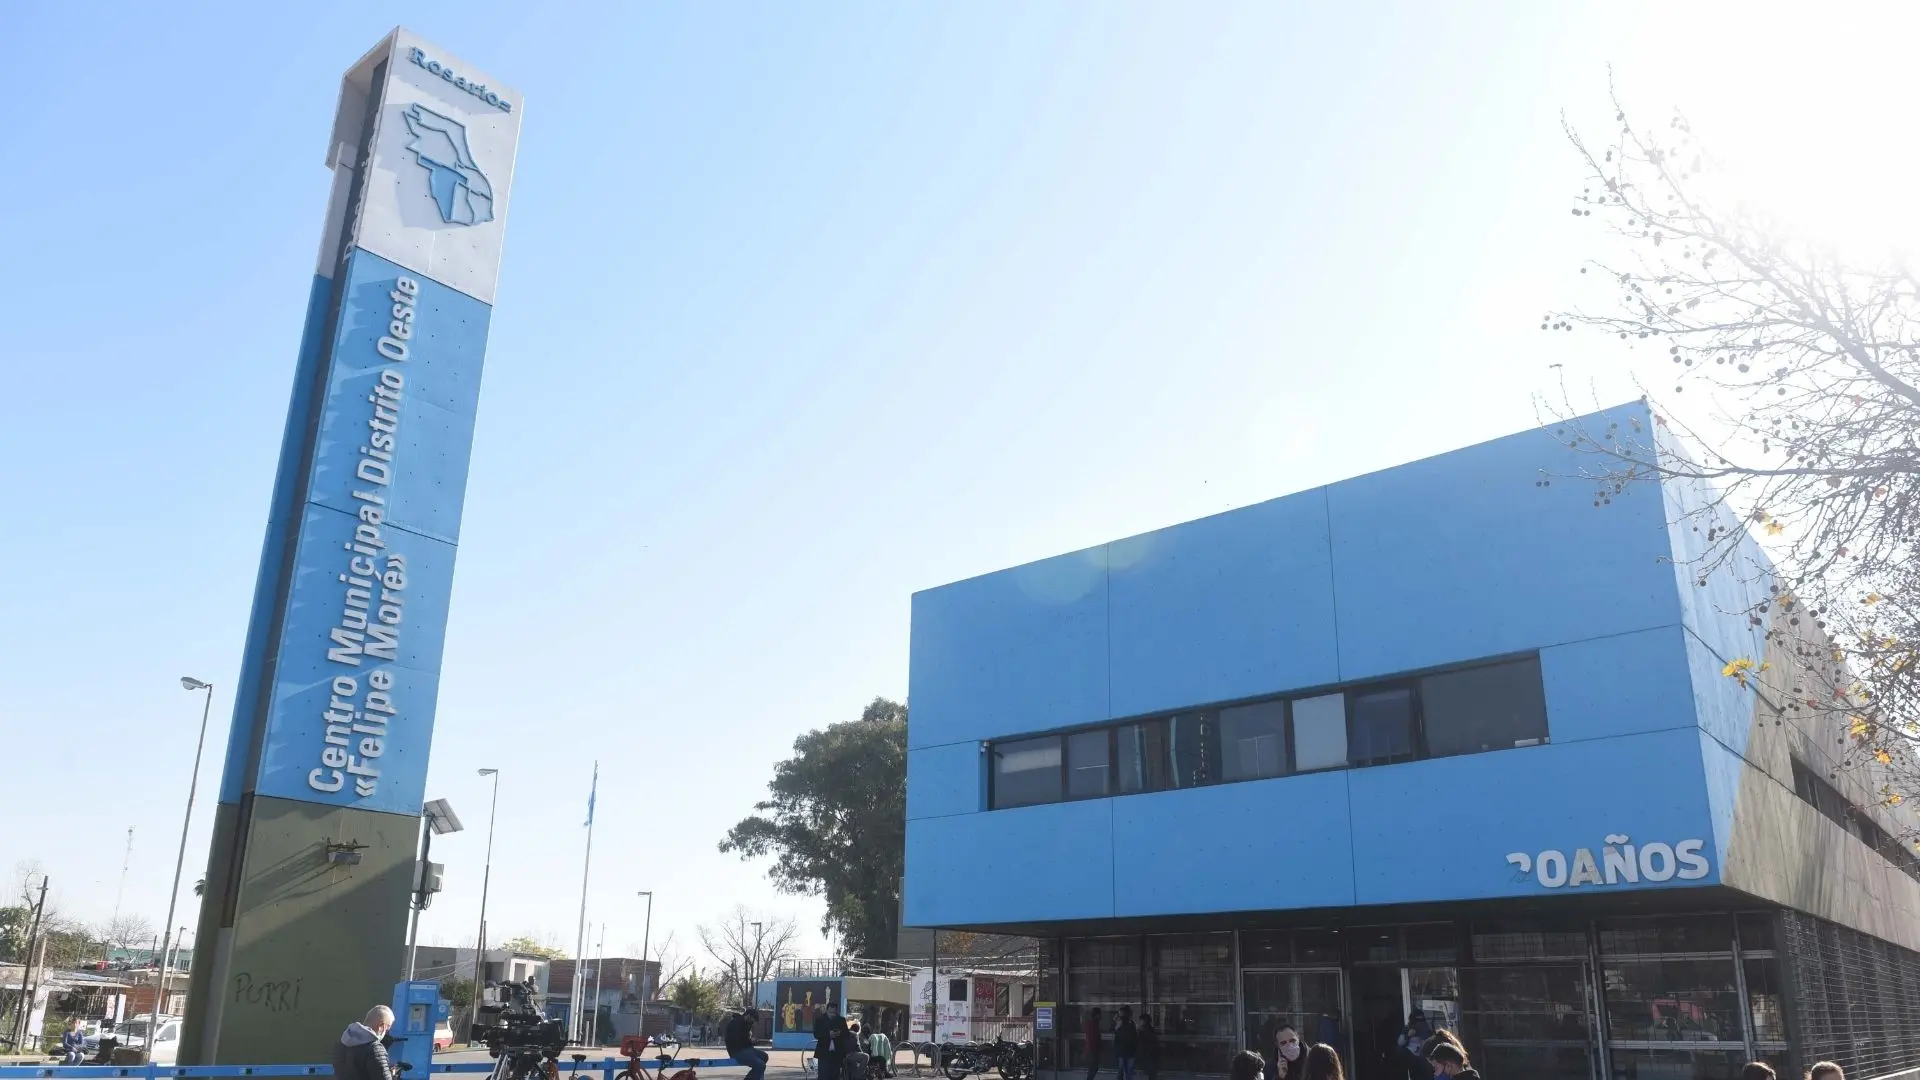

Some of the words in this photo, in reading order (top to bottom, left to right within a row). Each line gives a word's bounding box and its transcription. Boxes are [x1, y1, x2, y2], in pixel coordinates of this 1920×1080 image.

[377, 276, 418, 362] Oeste
[357, 369, 404, 487] Distrito
[328, 490, 385, 666] Municipal
[364, 553, 406, 661] Moré»
[308, 676, 358, 793] Centro
[347, 670, 396, 797] «Felipe
